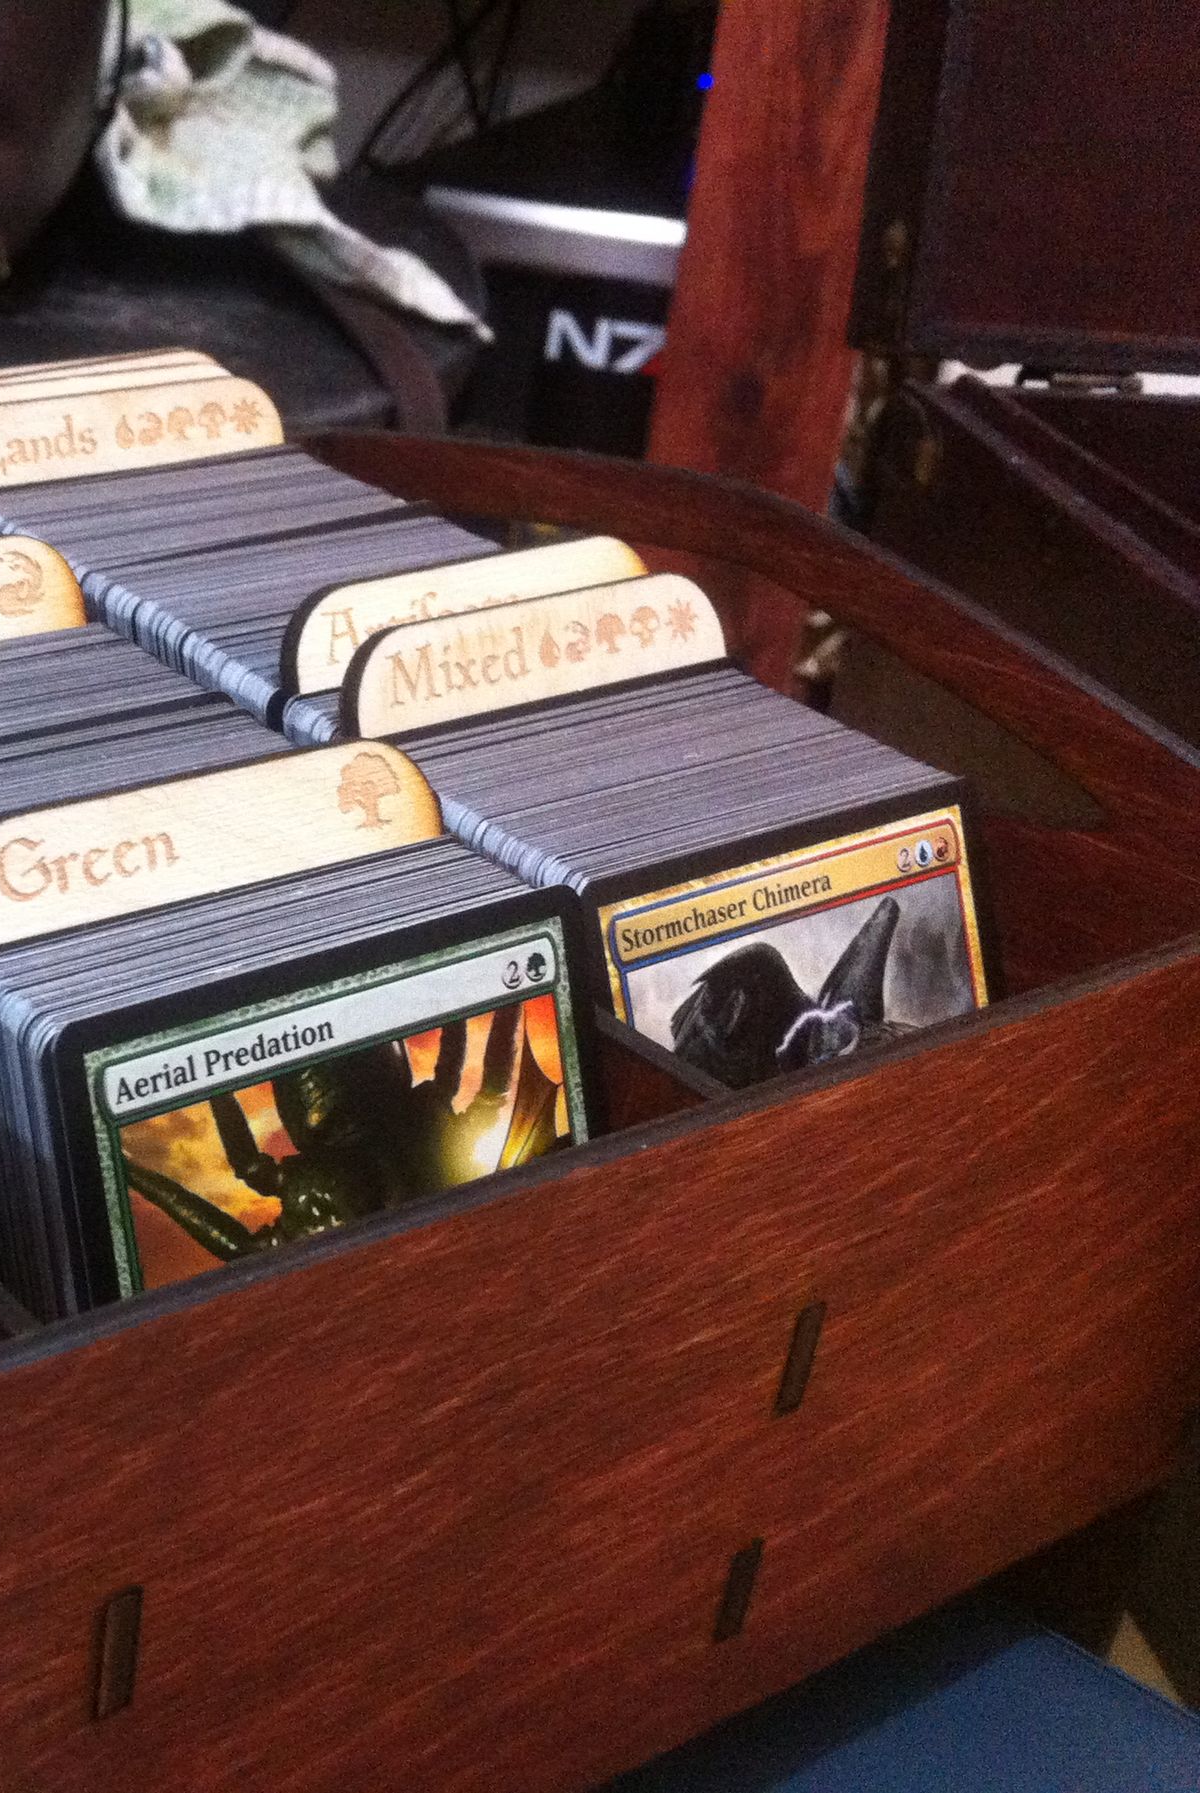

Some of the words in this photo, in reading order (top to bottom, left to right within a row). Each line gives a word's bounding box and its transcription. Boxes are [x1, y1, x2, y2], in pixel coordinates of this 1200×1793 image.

[544, 308, 666, 373] N7
[385, 626, 531, 708] Mixed
[621, 899, 748, 952] Stormchaser
[752, 874, 832, 912] Chimera
[115, 1054, 197, 1105] Aerial
[204, 1021, 334, 1077] Predation
